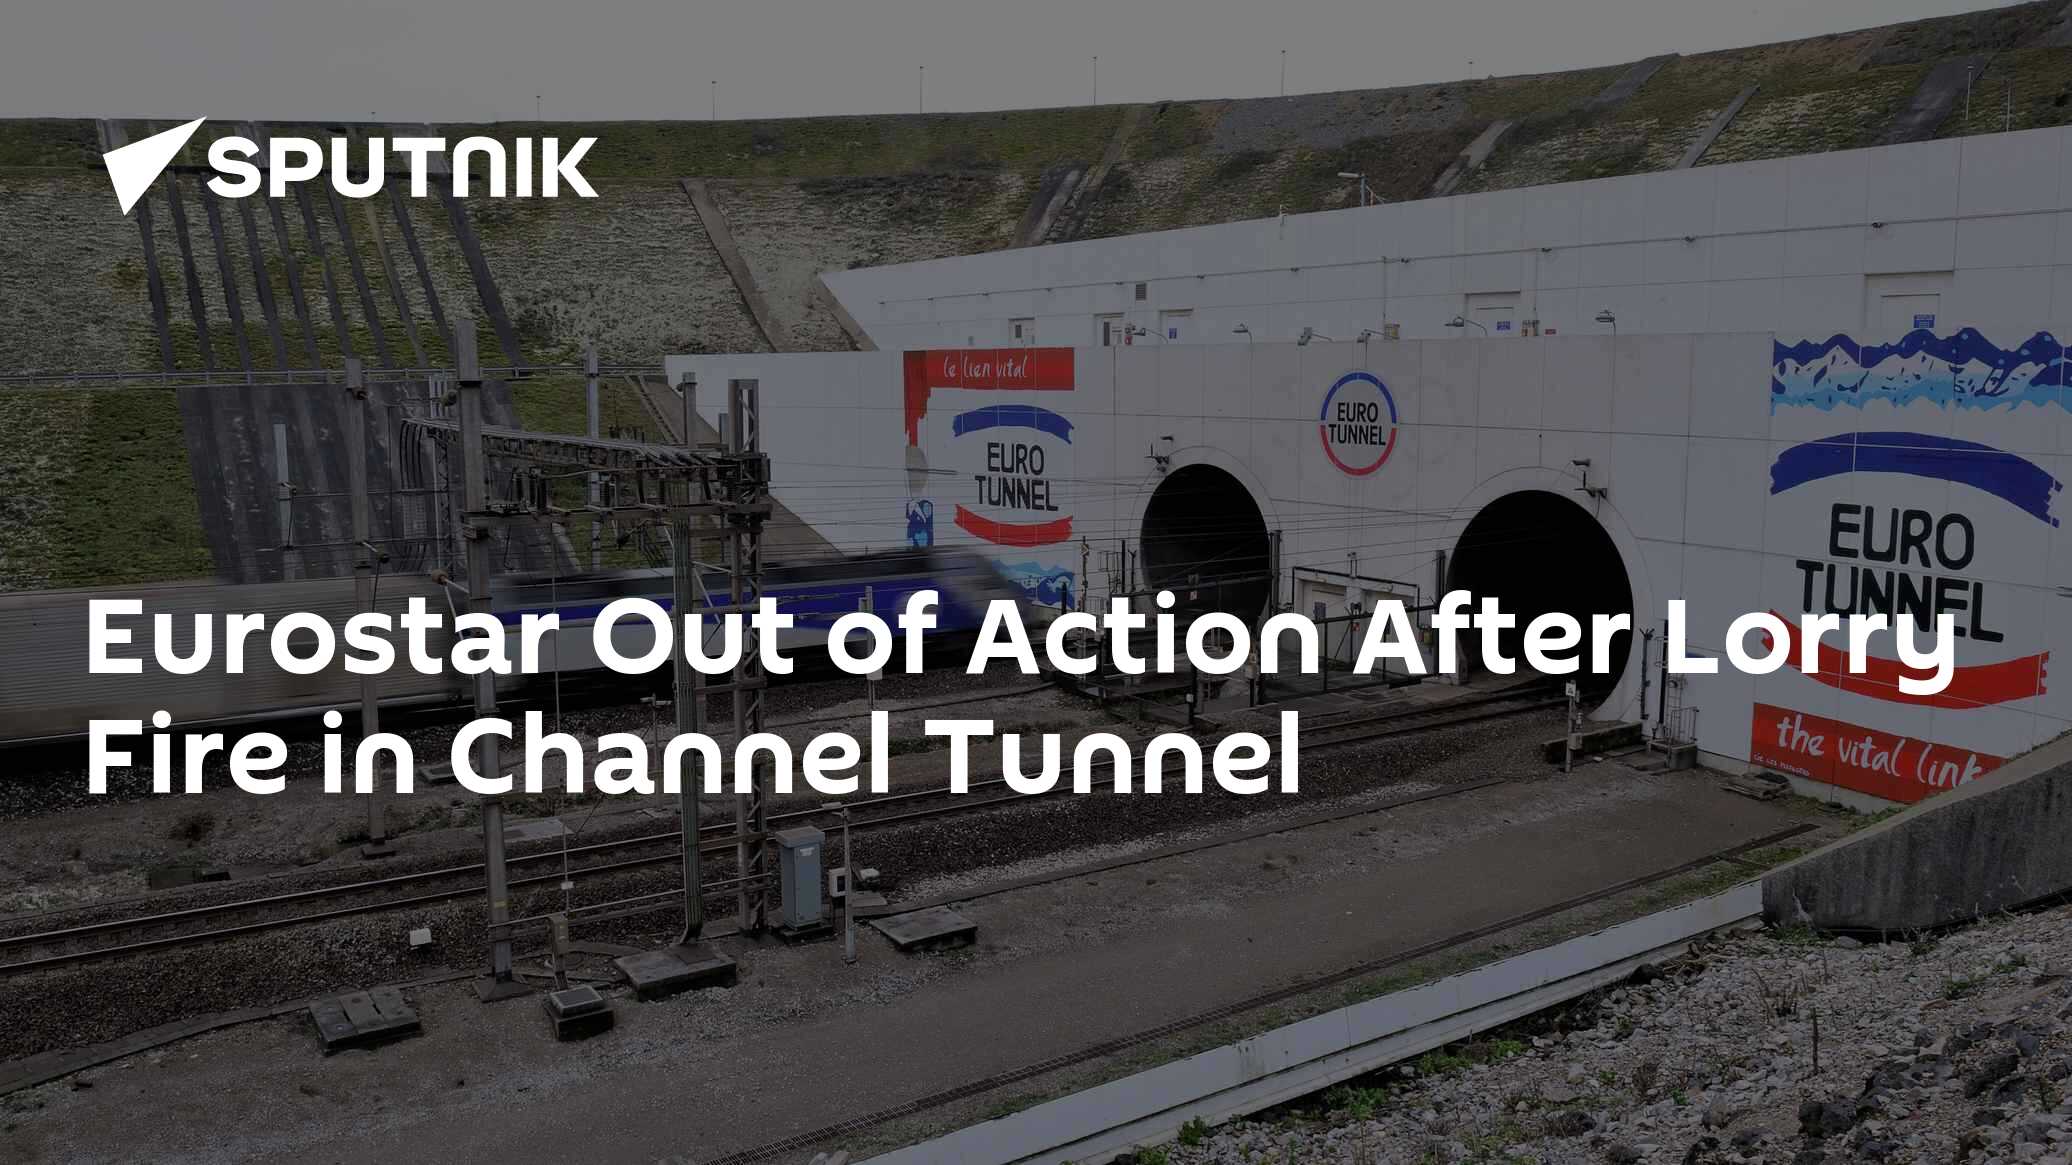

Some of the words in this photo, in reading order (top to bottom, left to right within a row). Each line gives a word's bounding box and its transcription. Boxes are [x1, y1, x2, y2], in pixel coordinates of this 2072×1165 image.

[943, 355, 957, 378] le
[963, 354, 991, 378] lien
[995, 353, 1029, 378] vital
[1337, 402, 1379, 423] EURO
[1328, 424, 1386, 446] TUNNEL
[987, 442, 1045, 476] EURO
[974, 475, 1059, 512] TUNNEL
[1829, 502, 1975, 571] EURO
[1795, 559, 2005, 643] TUNNEL
[1776, 714, 1825, 757] the
[1838, 736, 1906, 777] vital
[1916, 743, 1983, 788] link
